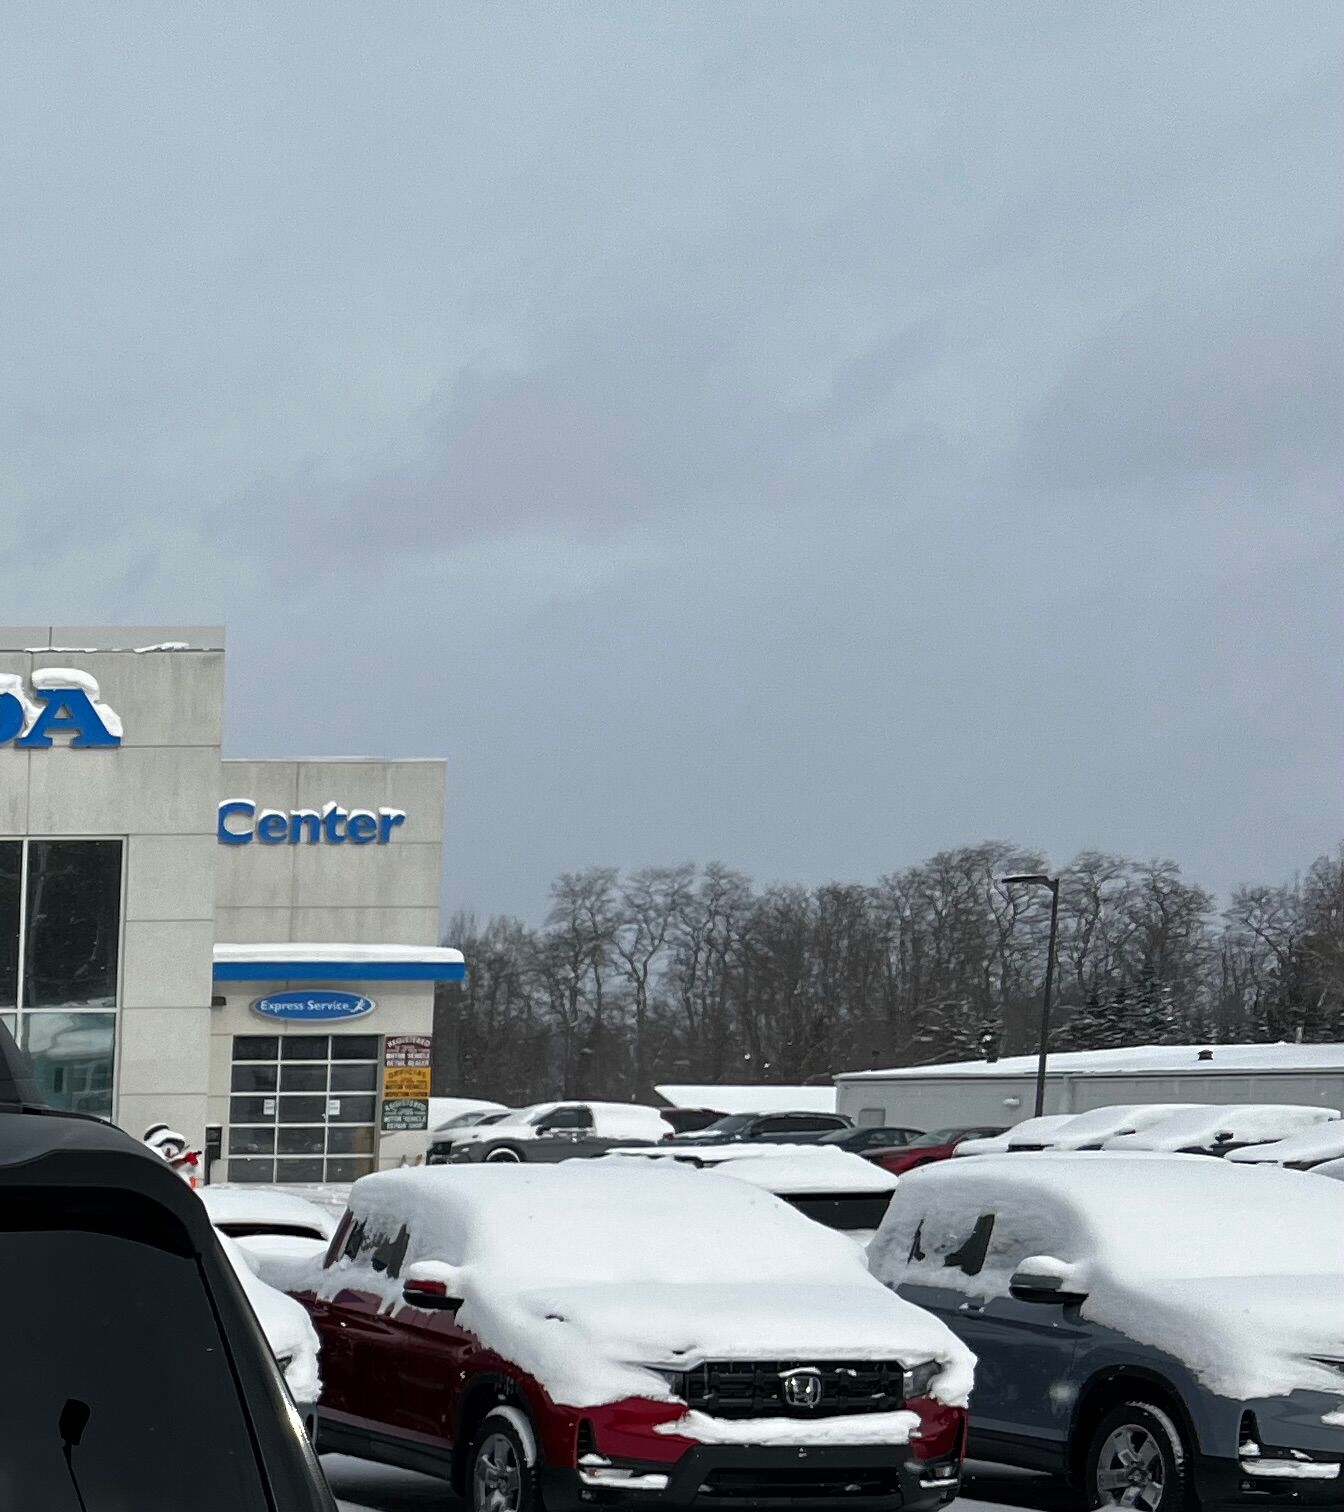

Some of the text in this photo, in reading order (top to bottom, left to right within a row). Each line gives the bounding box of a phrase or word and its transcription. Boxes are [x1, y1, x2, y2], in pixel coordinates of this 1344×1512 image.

[217, 800, 407, 845] Center
[260, 1000, 350, 1013] Express Service
